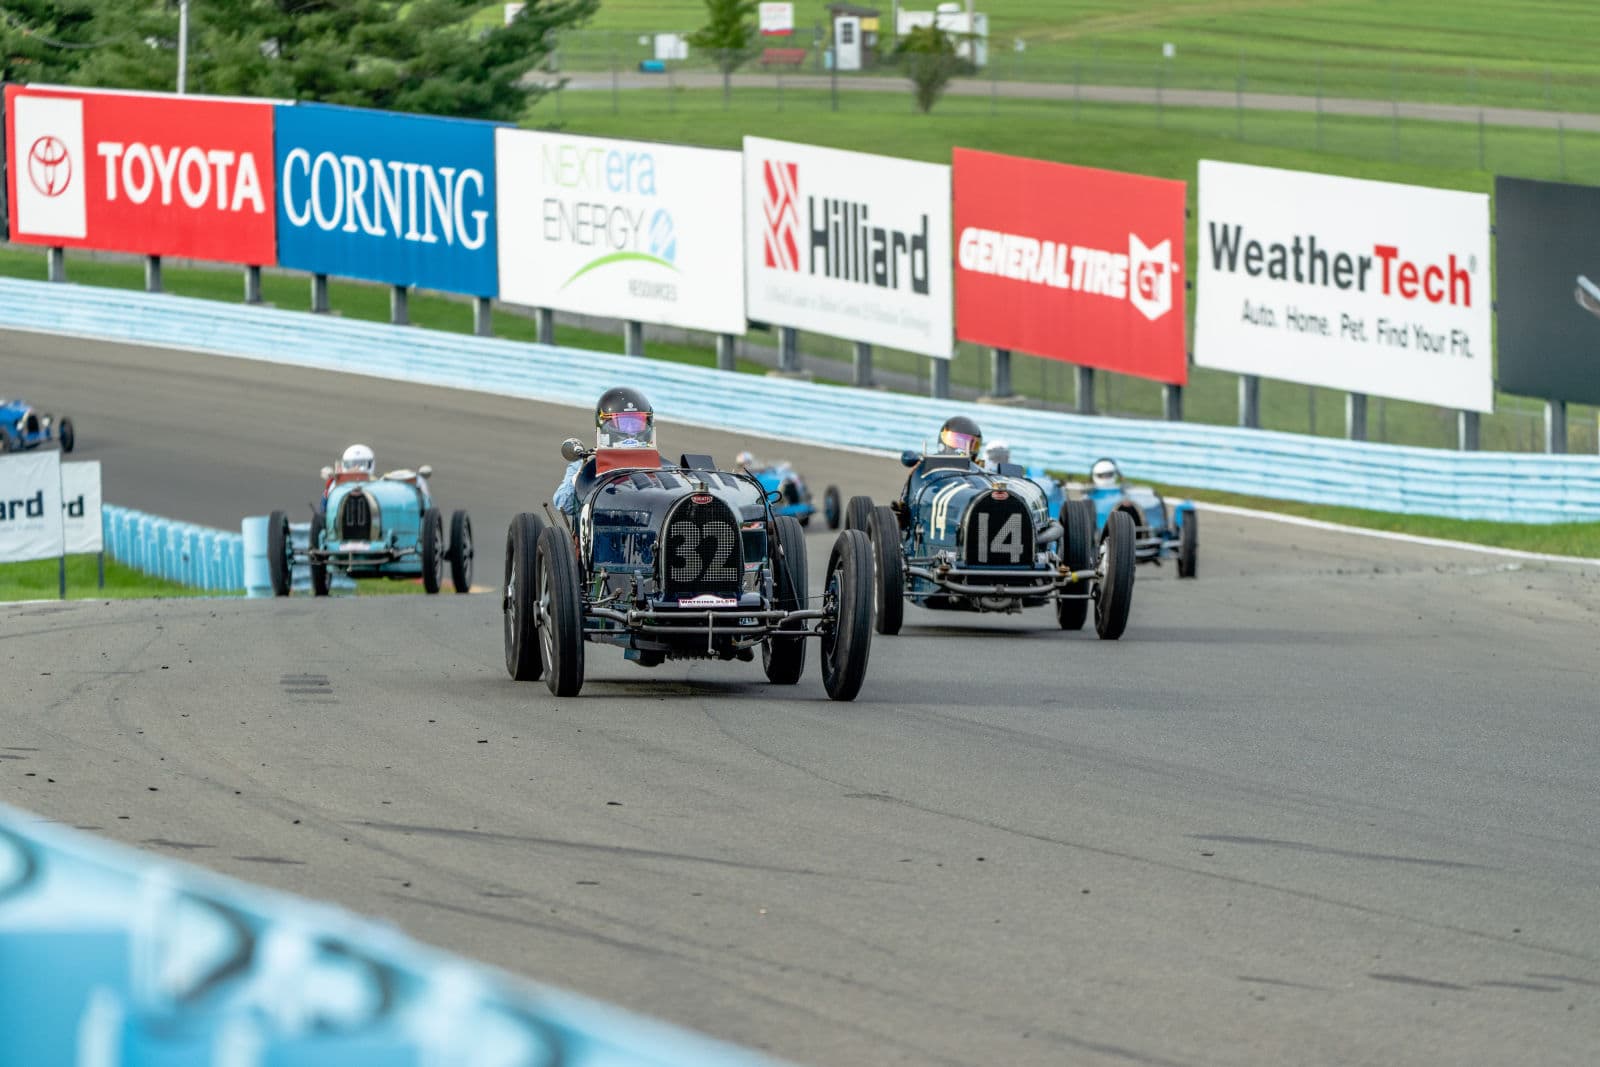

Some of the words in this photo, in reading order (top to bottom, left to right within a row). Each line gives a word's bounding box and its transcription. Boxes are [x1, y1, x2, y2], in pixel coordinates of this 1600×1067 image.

[97, 141, 266, 214] TOYOTA
[282, 147, 489, 250] CORNING
[541, 143, 656, 196] NEXTera
[544, 198, 645, 250] ENERGY
[809, 196, 929, 295] Hilliard
[958, 226, 1070, 289] GENERAL
[1070, 245, 1129, 300] TIRE
[1209, 220, 1472, 308] WeatherTech
[1241, 299, 1278, 328] Auto.
[1286, 305, 1332, 337] Home.
[1340, 312, 1369, 343] Pet.
[1376, 317, 1409, 349] Find
[1412, 322, 1447, 354] Your
[1450, 328, 1475, 359] Fit.
[671, 520, 738, 582] 32
[977, 512, 1024, 564] 14
